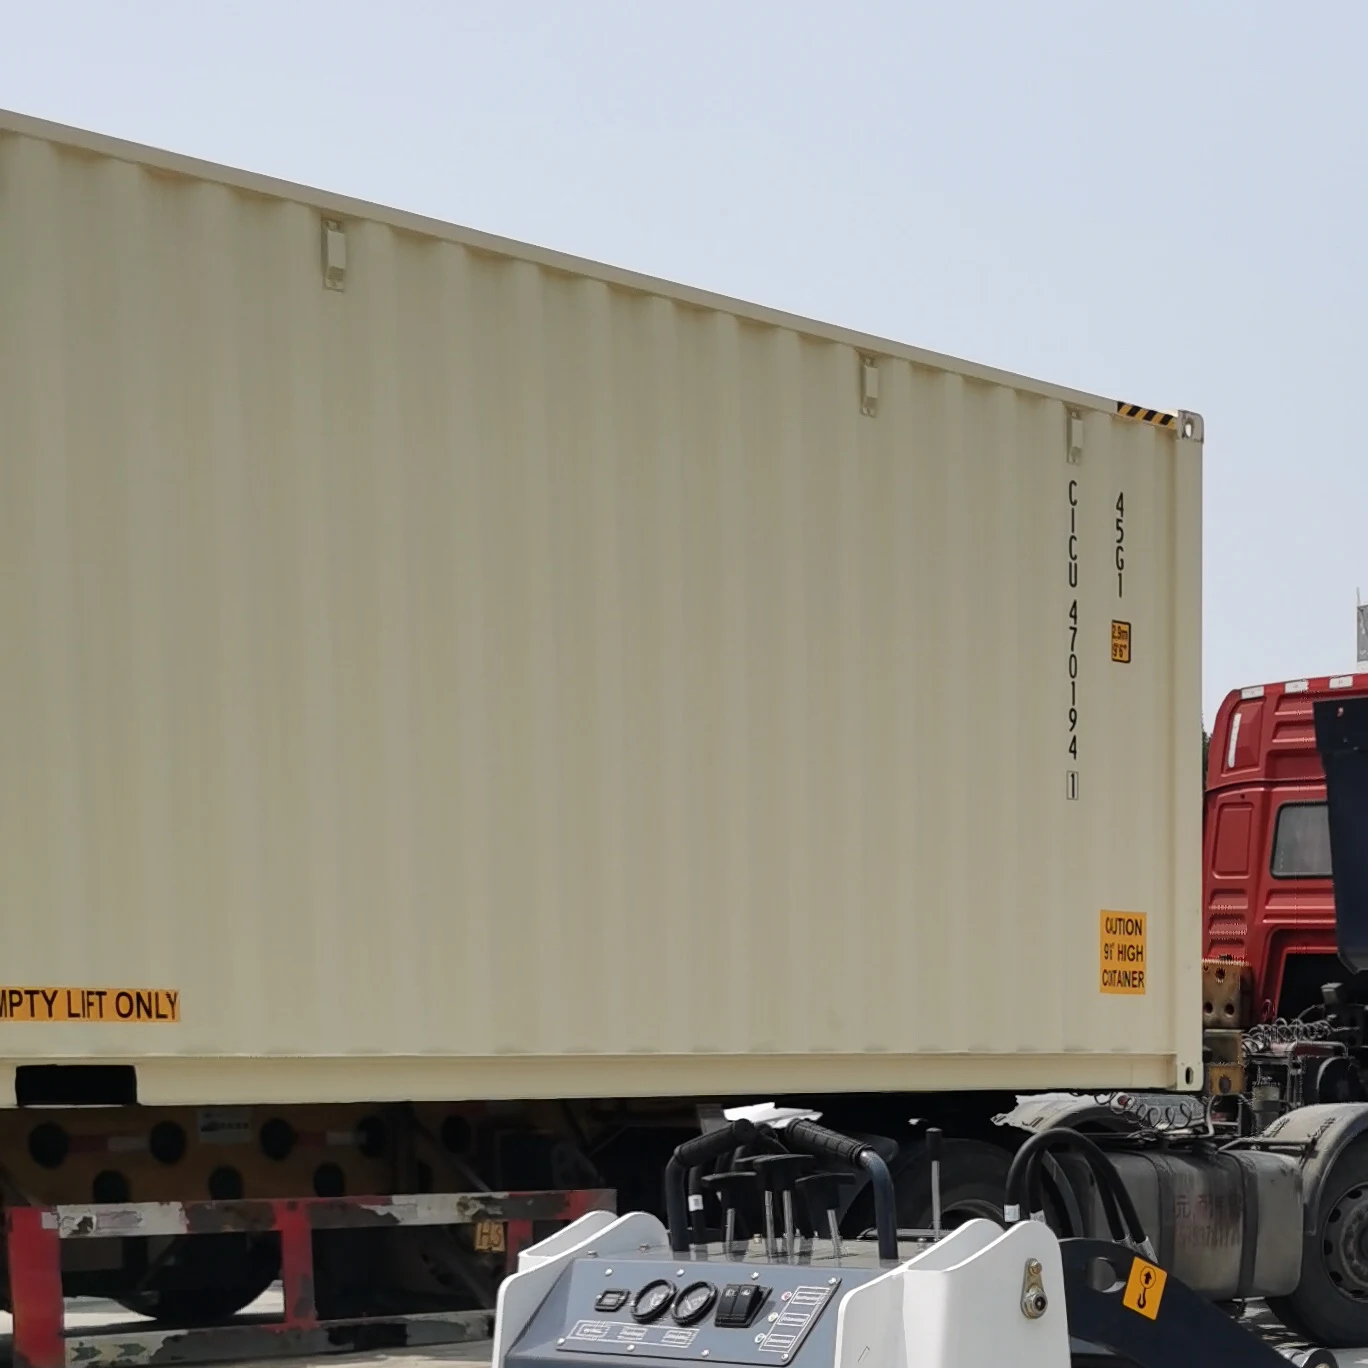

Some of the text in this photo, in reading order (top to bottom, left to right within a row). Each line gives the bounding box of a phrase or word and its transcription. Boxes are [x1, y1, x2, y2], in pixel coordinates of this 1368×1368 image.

[1069, 480, 1077, 588] CICU
[1116, 491, 1124, 598] 45G1
[1068, 599, 1078, 760] 470194
[67, 990, 107, 1018] LIFT
[115, 991, 177, 1019] ONLY
[1117, 944, 1143, 962] HIGH
